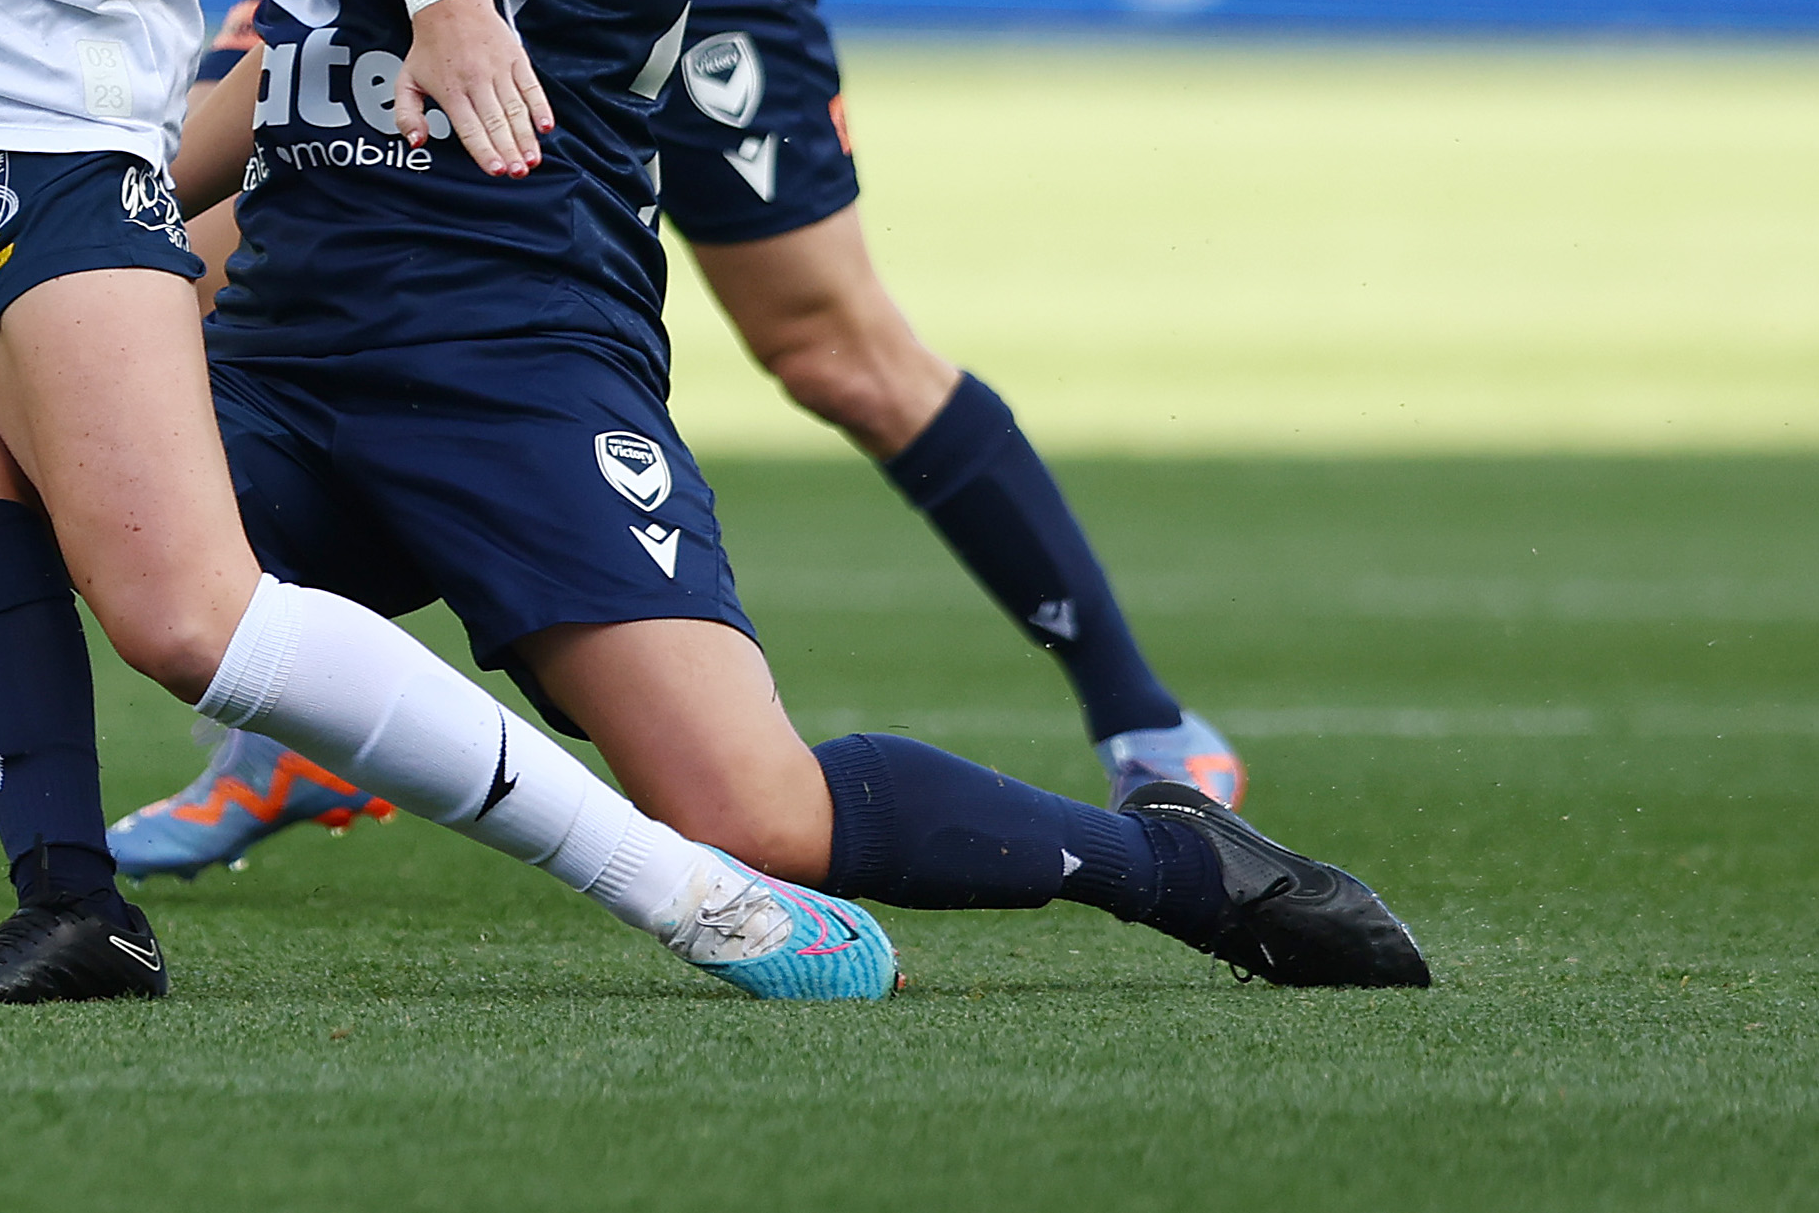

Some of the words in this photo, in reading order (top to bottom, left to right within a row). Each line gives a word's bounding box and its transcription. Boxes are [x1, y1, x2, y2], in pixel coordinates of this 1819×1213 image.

[95, 85, 124, 109] 23
[291, 137, 433, 171] mobile
[608, 444, 654, 465] Victory
